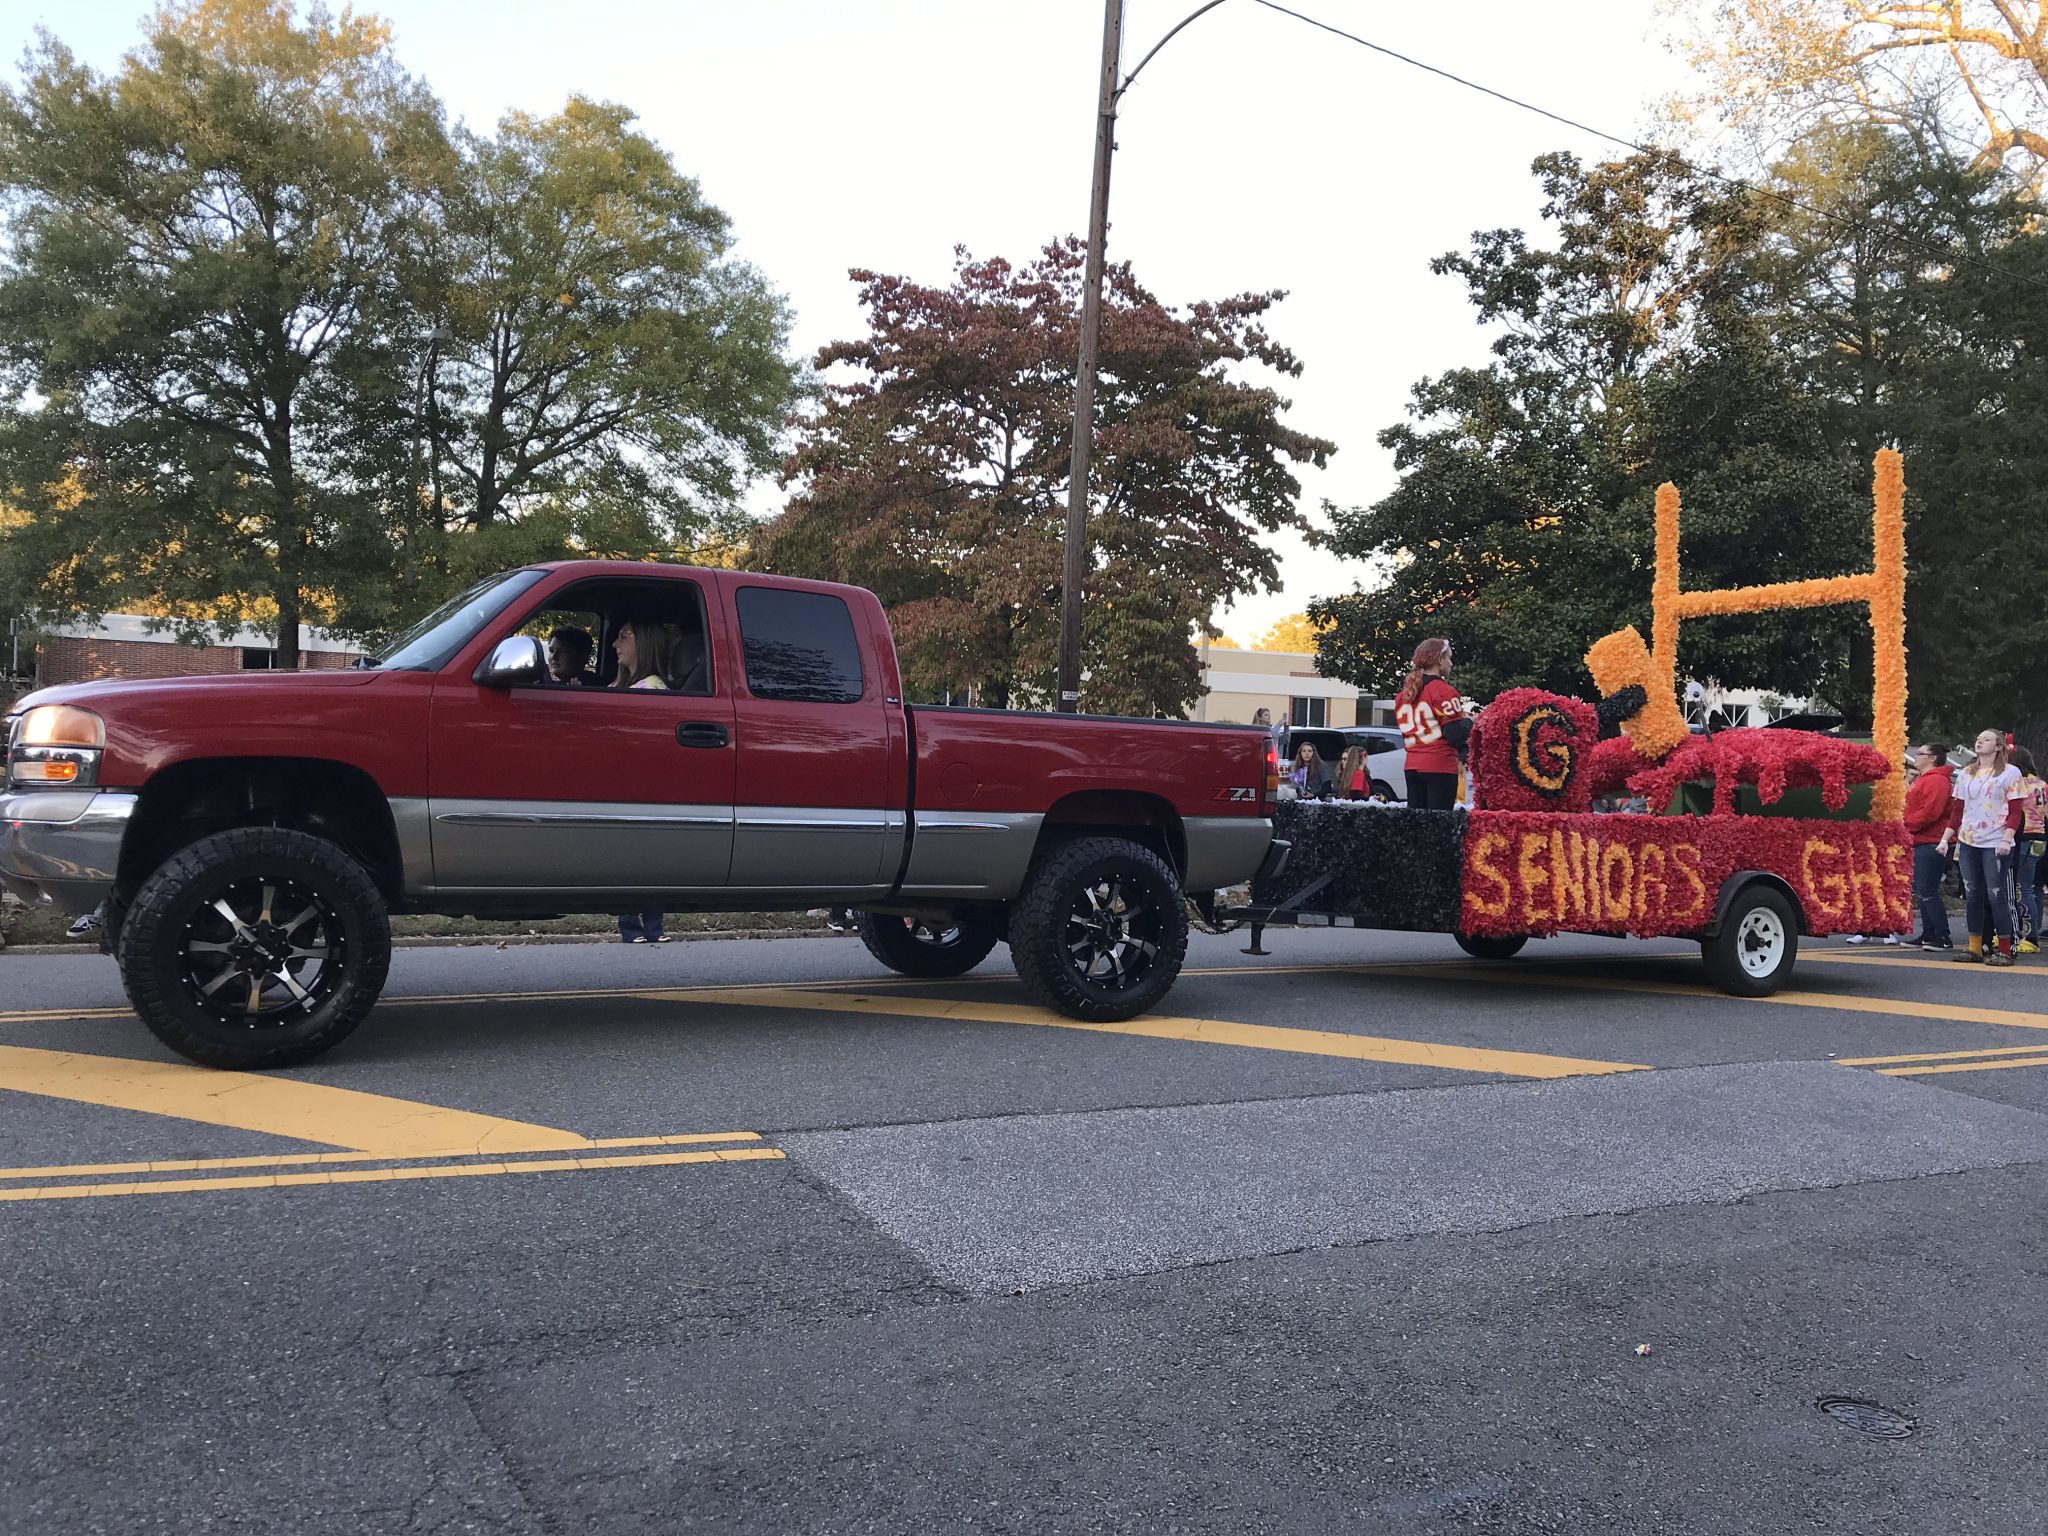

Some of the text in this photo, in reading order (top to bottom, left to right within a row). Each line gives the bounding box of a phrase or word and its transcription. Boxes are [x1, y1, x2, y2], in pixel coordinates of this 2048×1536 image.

[1396, 701, 1443, 748] 20
[1441, 696, 1462, 716] 20
[1510, 704, 1577, 797] G
[1213, 787, 1256, 800] Z71
[1465, 829, 1706, 925] SENIORS
